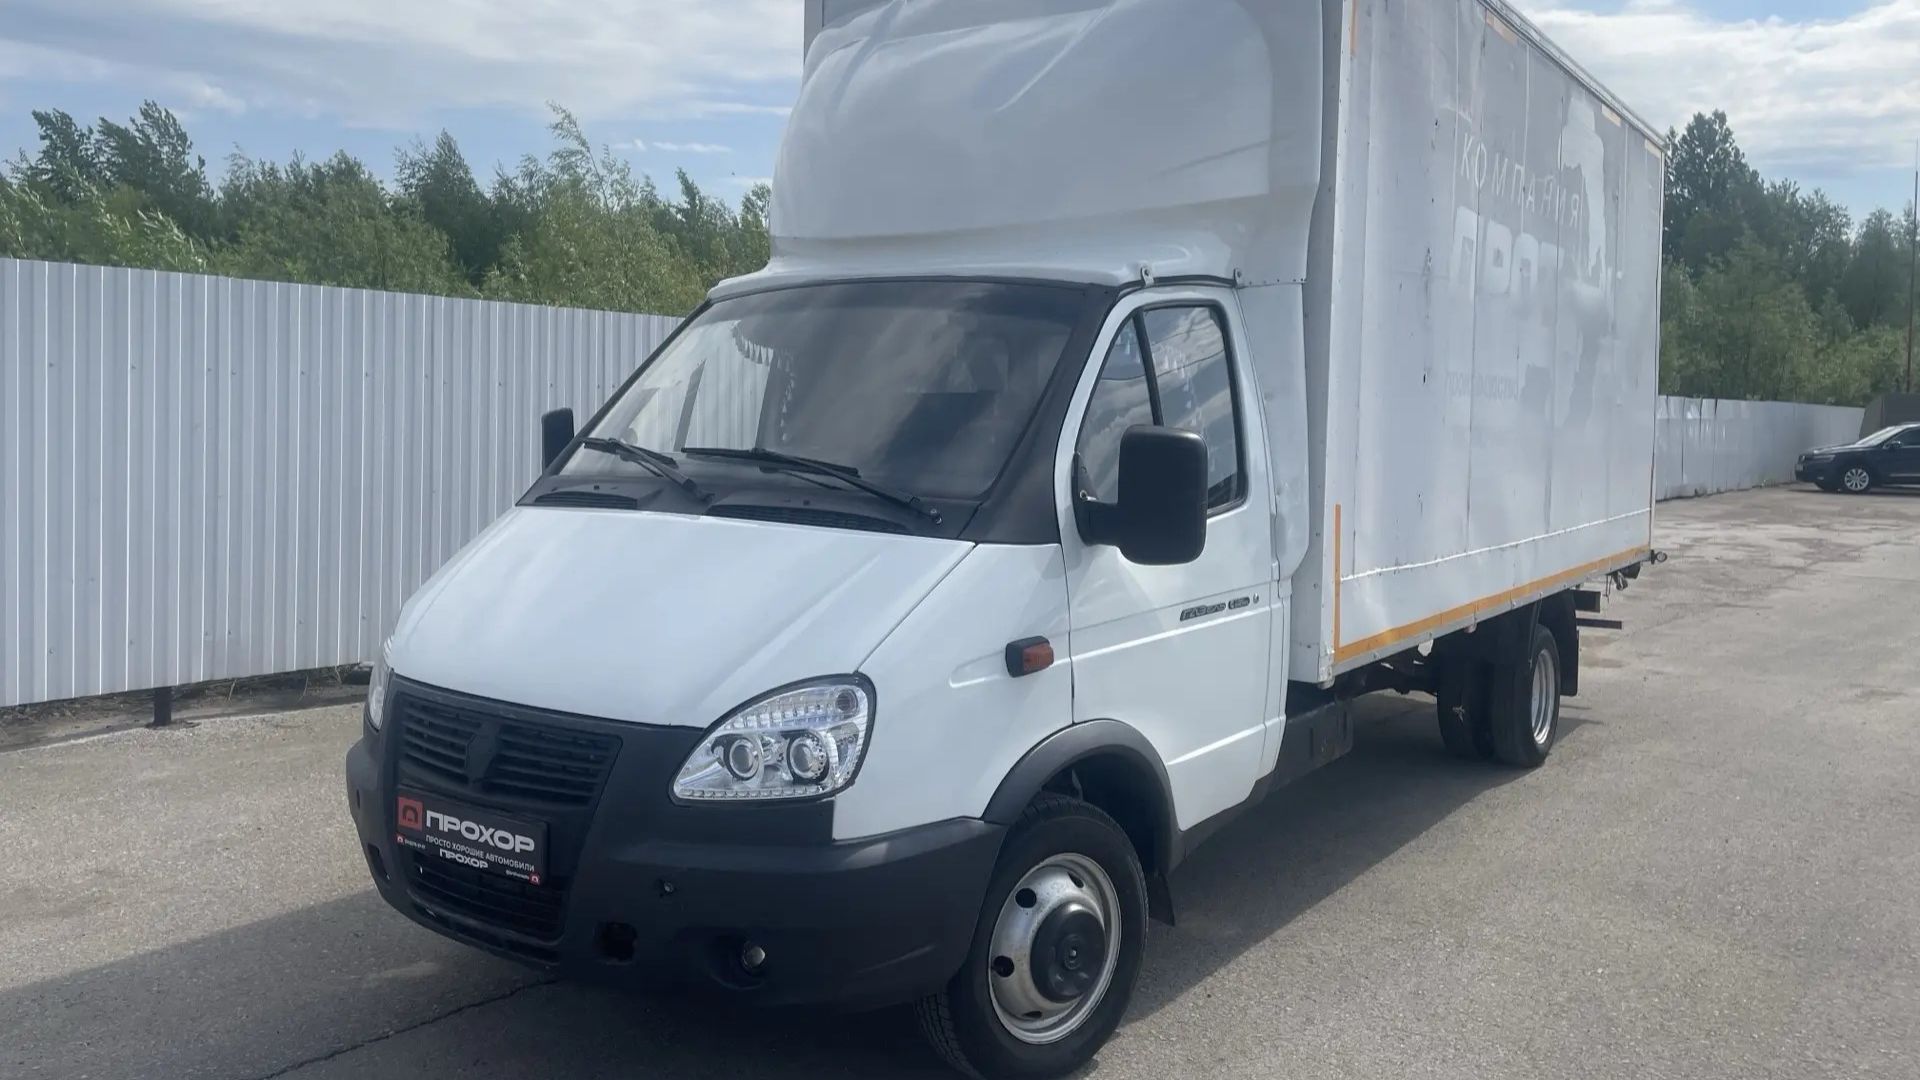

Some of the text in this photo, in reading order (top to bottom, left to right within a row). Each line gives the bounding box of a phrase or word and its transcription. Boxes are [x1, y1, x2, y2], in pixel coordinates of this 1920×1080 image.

[1460, 132, 1580, 228] КОМПАНИЯ
[426, 810, 535, 853] ПРОХОР
[426, 835, 451, 849] ПРОСТО
[452, 843, 484, 860] ХОРОШИЕ
[485, 853, 535, 872] АВТОМОБИЛИ
[439, 848, 489, 869] ПРОХОР
